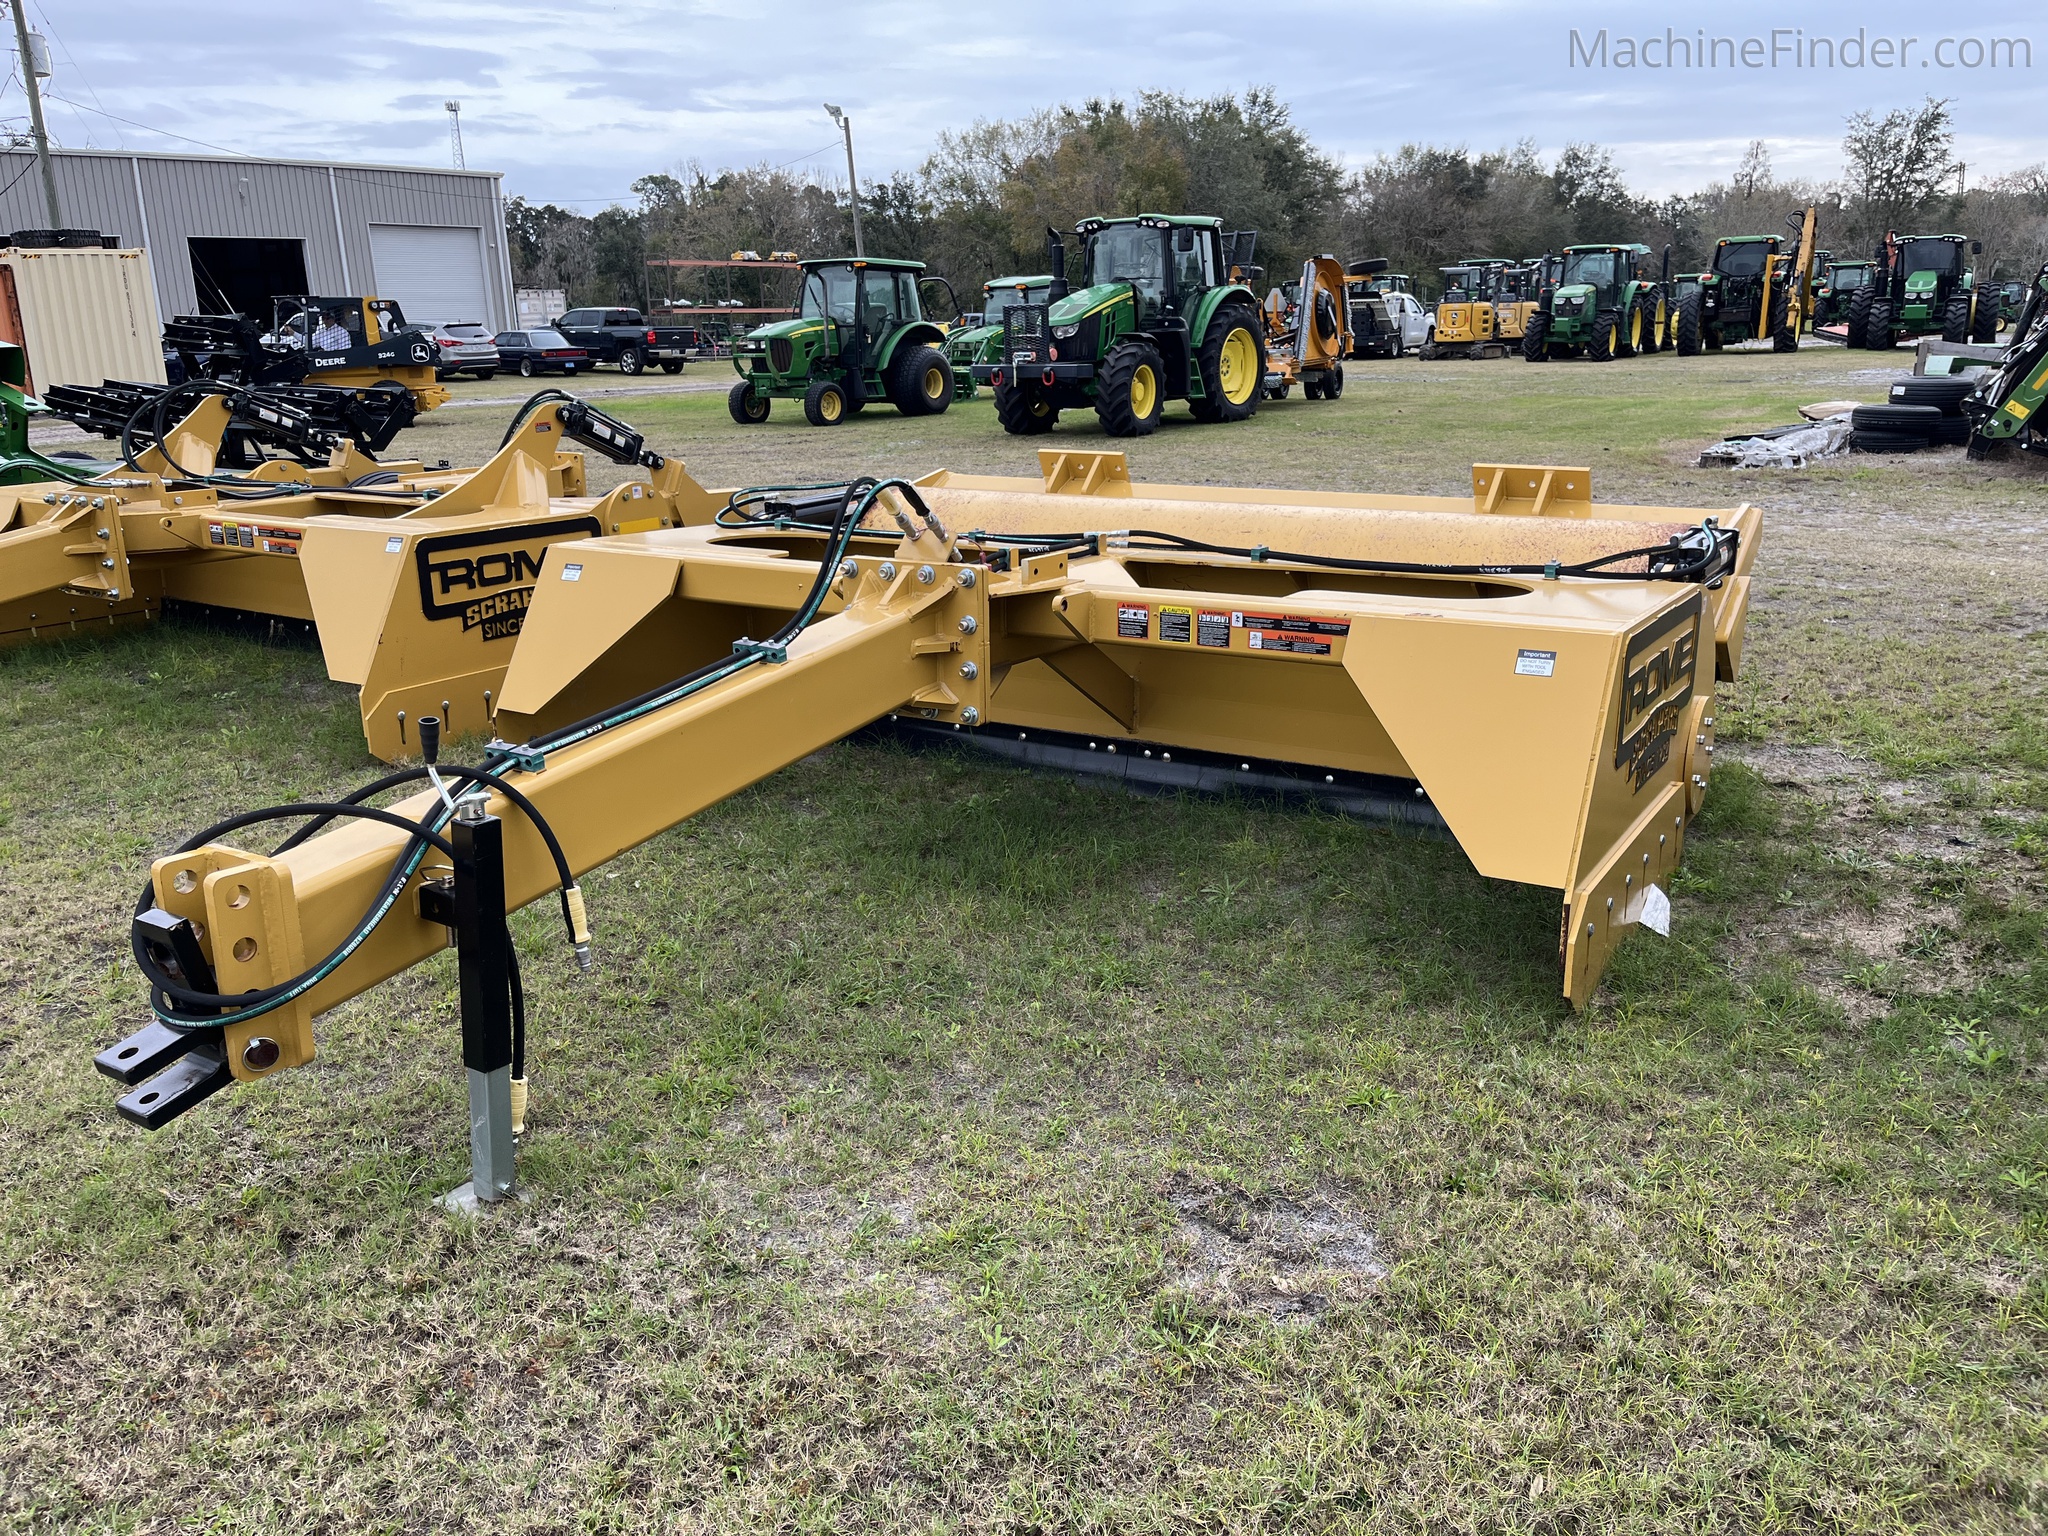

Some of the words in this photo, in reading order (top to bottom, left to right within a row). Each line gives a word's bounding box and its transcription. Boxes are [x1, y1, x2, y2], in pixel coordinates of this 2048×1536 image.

[315, 357, 346, 367] DEERE
[434, 546, 548, 594] ROM
[466, 589, 535, 626] SCRAP
[1284, 634, 1315, 643] WARNING
[1523, 651, 1552, 659] Important
[1624, 628, 1694, 724] ROME
[363, 896, 394, 935] WEATHERHEAD
